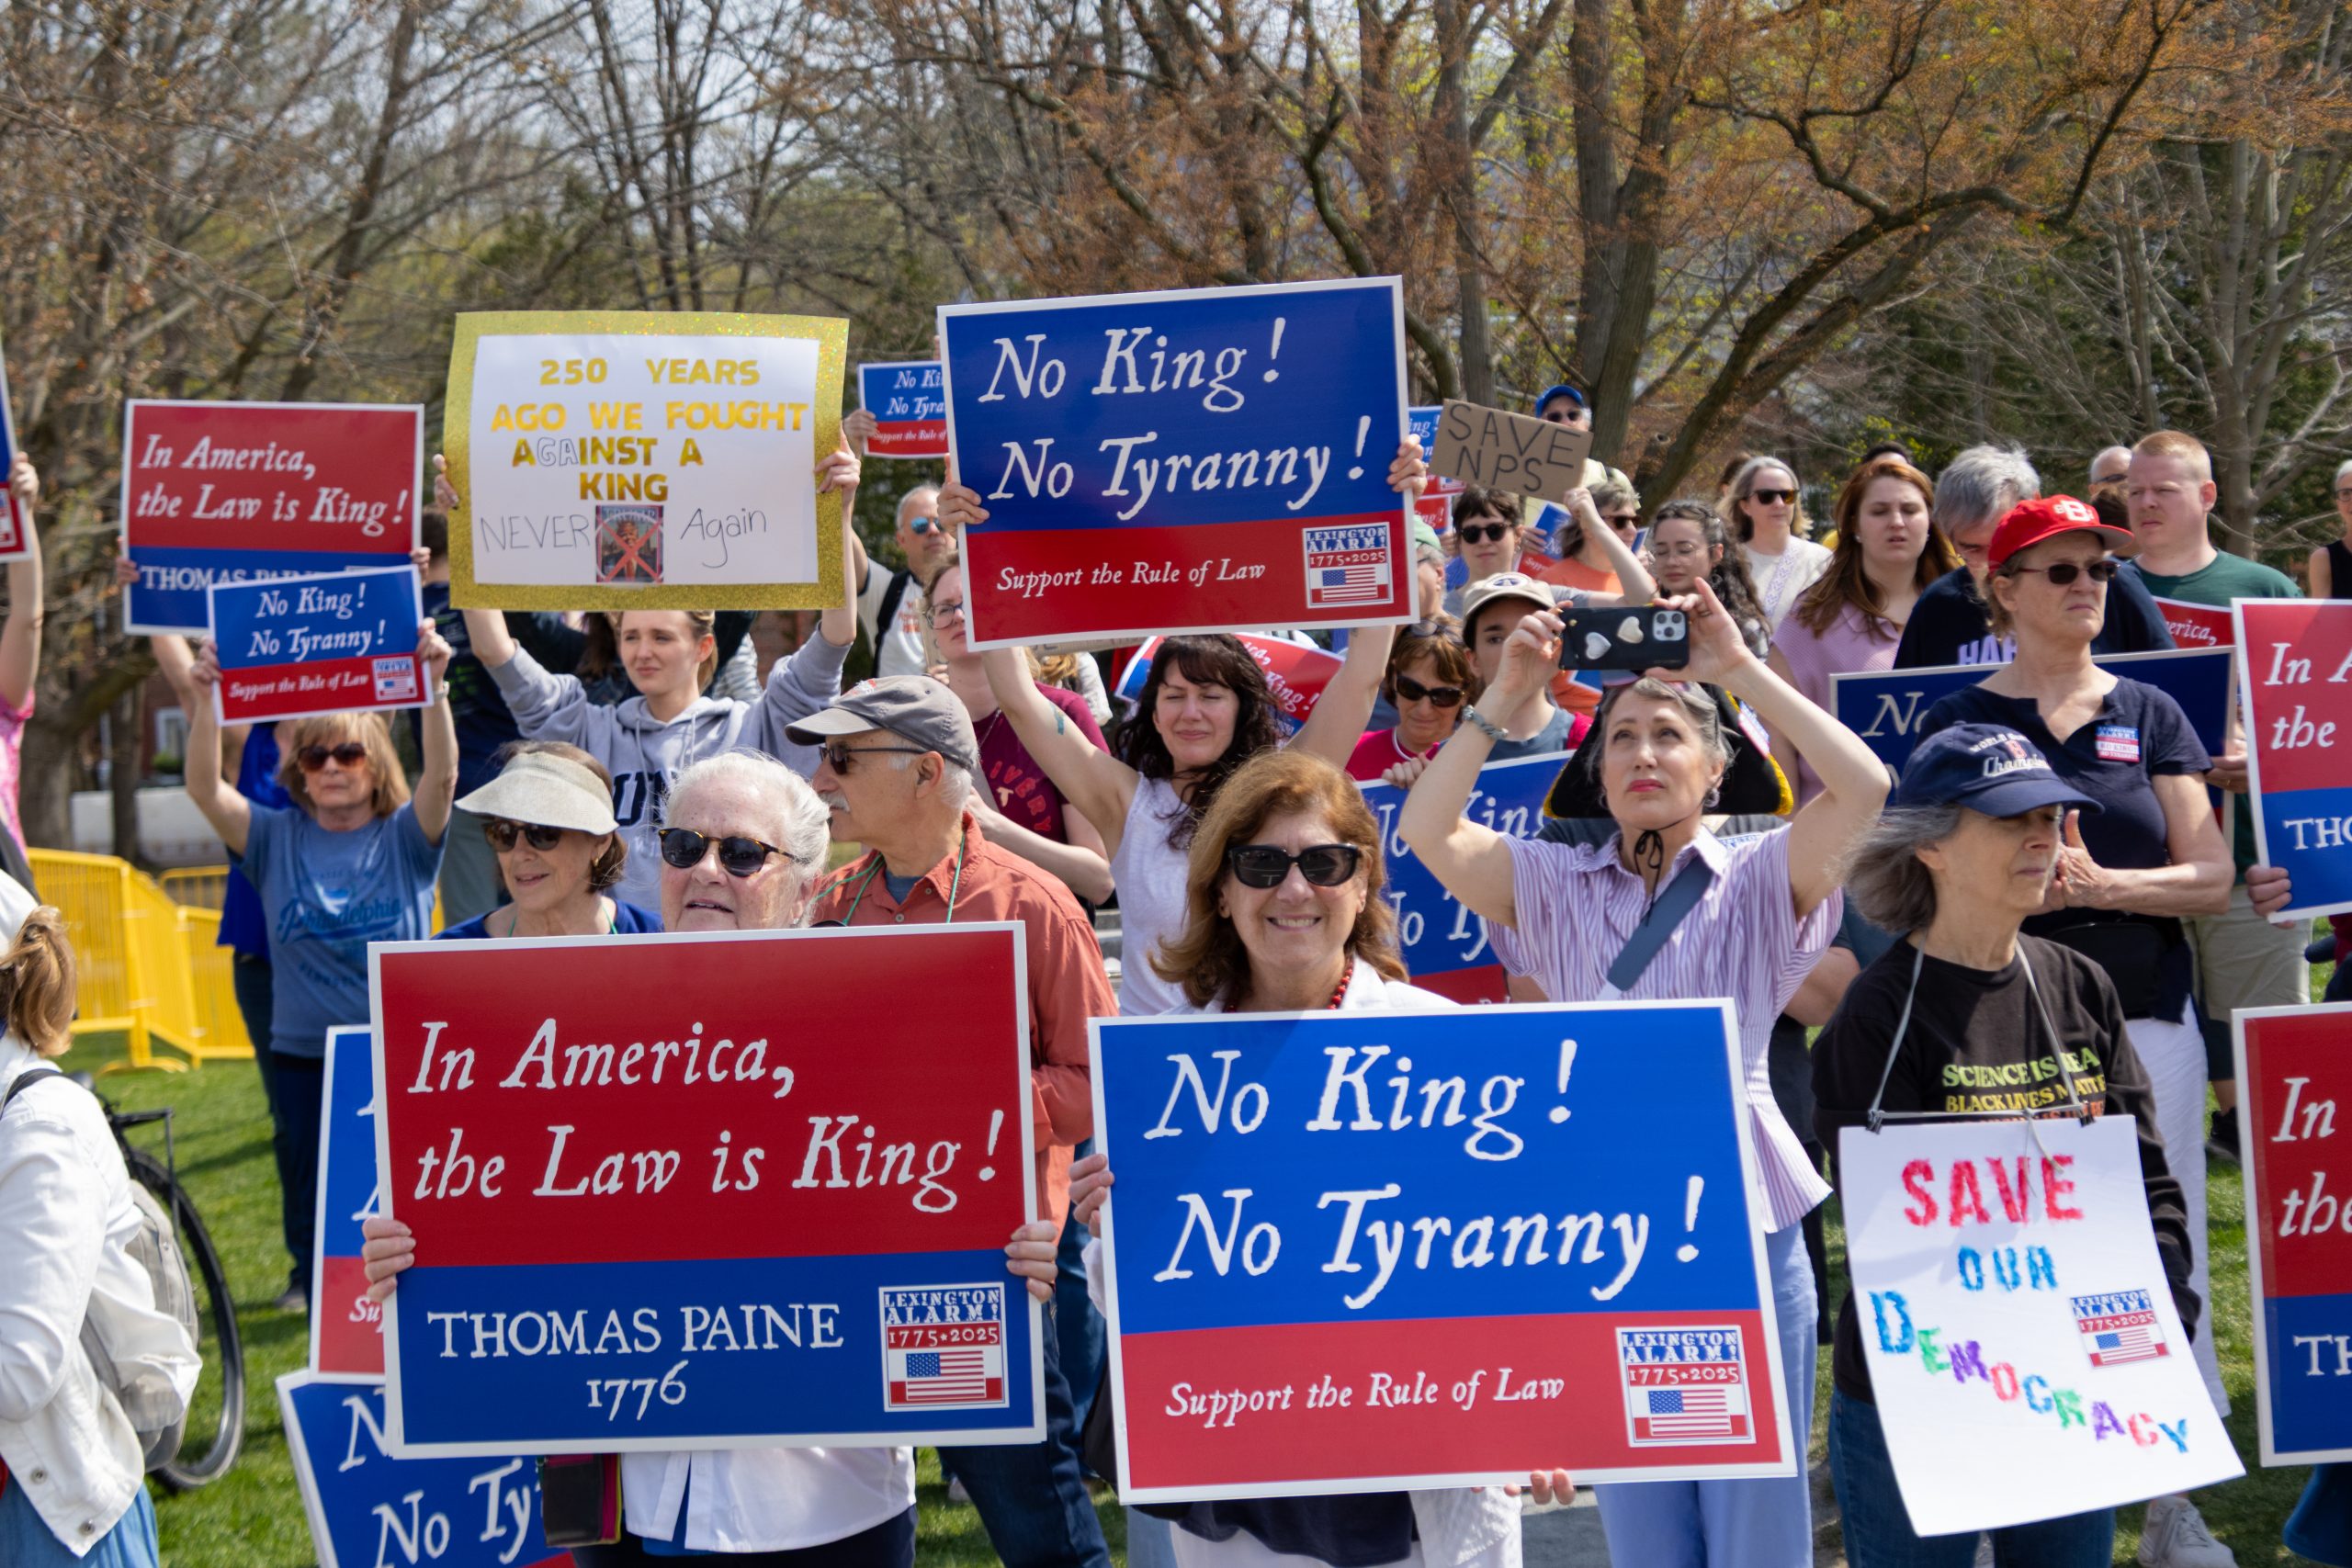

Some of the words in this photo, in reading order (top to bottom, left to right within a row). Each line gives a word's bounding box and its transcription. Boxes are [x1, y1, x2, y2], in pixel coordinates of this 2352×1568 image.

[539, 357, 608, 386] 250
[645, 357, 761, 386] YEARS
[893, 370, 917, 389] No
[978, 333, 1066, 402] No
[490, 402, 567, 432] AGO
[588, 401, 643, 431] WE
[665, 400, 809, 432] FOUGHT
[886, 396, 910, 415] No
[511, 436, 658, 468] AGAINST
[679, 437, 705, 467] A
[1448, 402, 1581, 469] SAVE
[138, 434, 174, 469] In
[180, 435, 316, 481] America,
[988, 438, 1074, 501] No
[1456, 445, 1544, 492] NPS
[135, 482, 182, 518] the
[191, 484, 262, 520] Law
[272, 491, 300, 522] is
[579, 472, 669, 502] KING
[480, 513, 591, 552] NEVER
[680, 507, 768, 569] Again
[1306, 526, 1387, 541] LEXINGTON
[1307, 536, 1386, 552] ALARM!
[996, 567, 1084, 599] Support
[1091, 562, 1123, 586] the
[1130, 561, 1180, 586] Rule
[1188, 559, 1213, 586] of
[1216, 558, 1266, 581] Law
[254, 590, 289, 619] No
[246, 629, 281, 659] No
[2165, 619, 2218, 646] erica,
[2263, 642, 2312, 685] In
[228, 681, 276, 703] Support
[278, 676, 296, 693] the
[299, 673, 325, 692] Rule
[329, 672, 342, 692] of
[344, 671, 369, 687] Law
[2270, 705, 2336, 750] the
[407, 1021, 476, 1095] In
[499, 1018, 797, 1100] America,
[1942, 1062, 2032, 1088] SCIENCE
[2030, 1055, 2060, 1082] IS
[1144, 1049, 1271, 1142] No
[1945, 1093, 2007, 1113] BLACK
[2004, 1086, 2056, 1111] LIVES
[2270, 1077, 2337, 1143] In
[414, 1127, 506, 1201] the
[533, 1123, 682, 1199] Law
[711, 1131, 765, 1194] is
[1900, 1155, 2086, 1228] SAVE
[1153, 1188, 1283, 1282] No
[1957, 1244, 2059, 1292] OUR
[884, 1290, 1001, 1308] LEXINGTON
[886, 1303, 999, 1325] ALARM!
[426, 1307, 663, 1361] THOMAS
[680, 1303, 845, 1355] PAINE
[1623, 1332, 1737, 1348] LEXINGTON
[1625, 1345, 1738, 1363] ALARM!
[1867, 1290, 2188, 1455] DEMOCRACY
[586, 1359, 688, 1423] 1776
[1165, 1381, 1297, 1429] Support
[1306, 1374, 1353, 1409] the
[1366, 1371, 1442, 1408] Rule
[1451, 1368, 1487, 1408] of
[1493, 1367, 1566, 1402] Law
[371, 1489, 451, 1568] No
[468, 1456, 542, 1565] Ty
